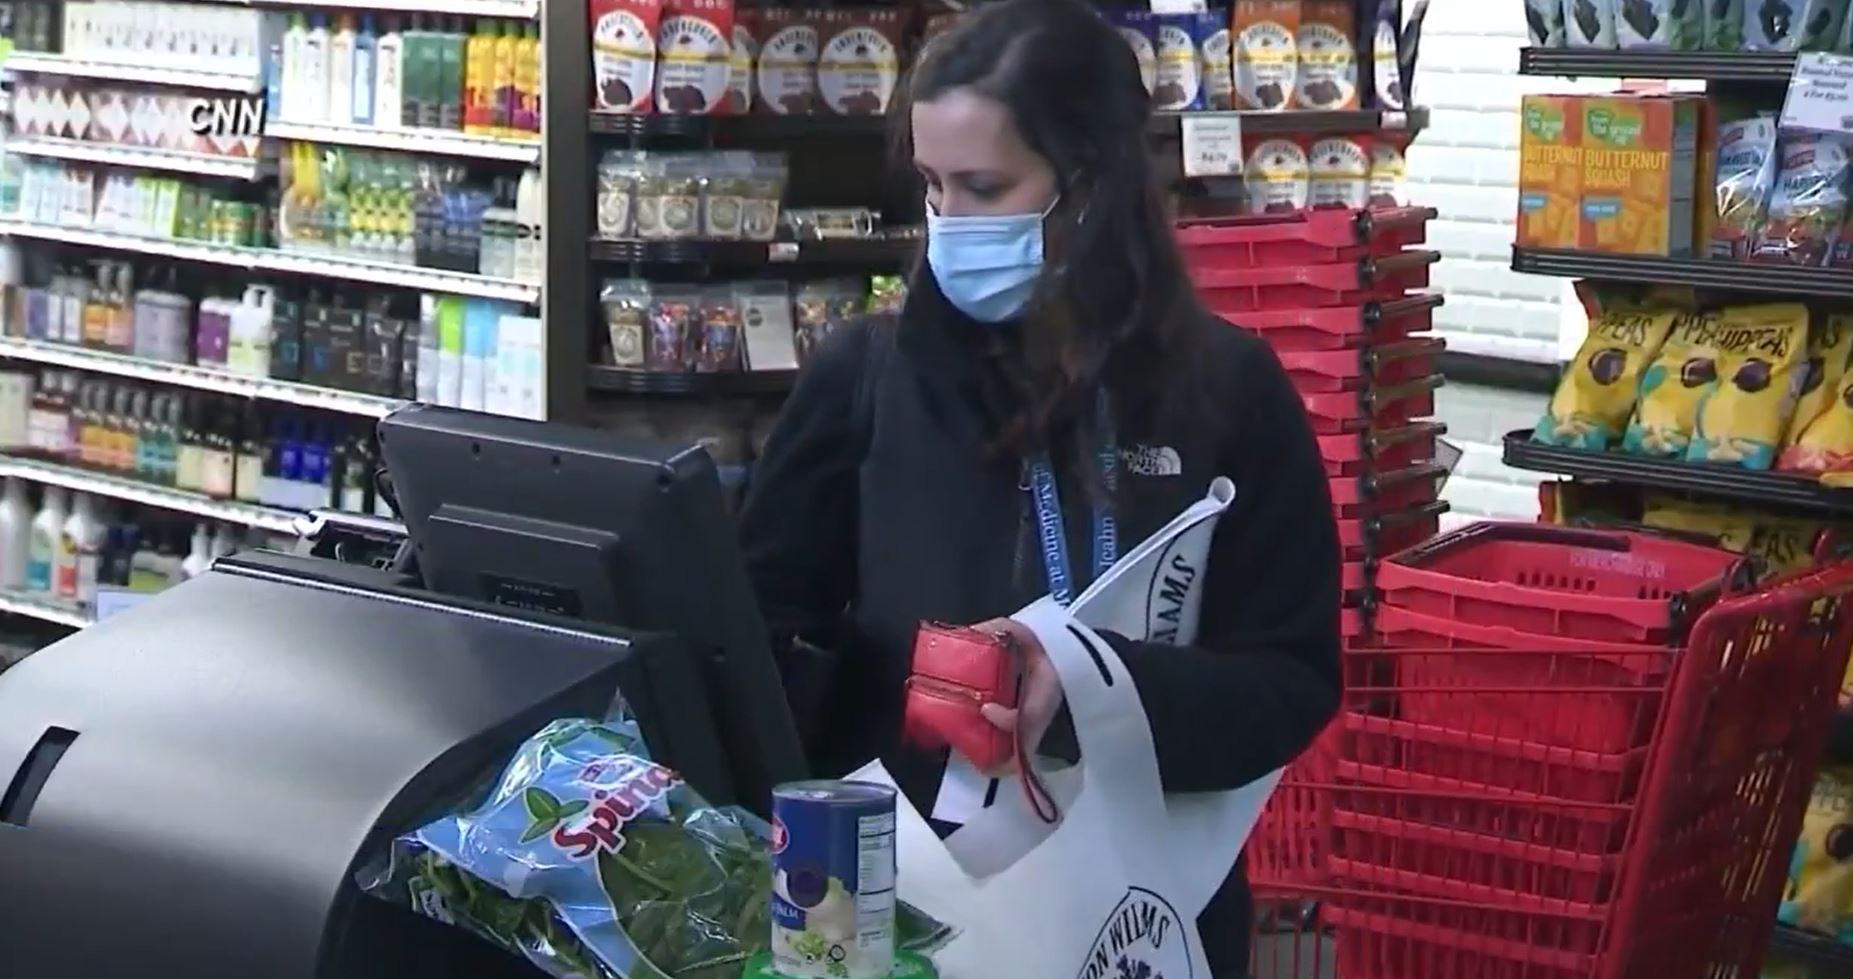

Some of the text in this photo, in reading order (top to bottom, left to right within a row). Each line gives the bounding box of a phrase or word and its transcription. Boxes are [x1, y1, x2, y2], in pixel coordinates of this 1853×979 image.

[1585, 151, 1669, 171] BUTTERNUT
[1584, 168, 1632, 189] SQUASH
[1036, 482, 1061, 562] Medicine
[1048, 565, 1065, 584] at
